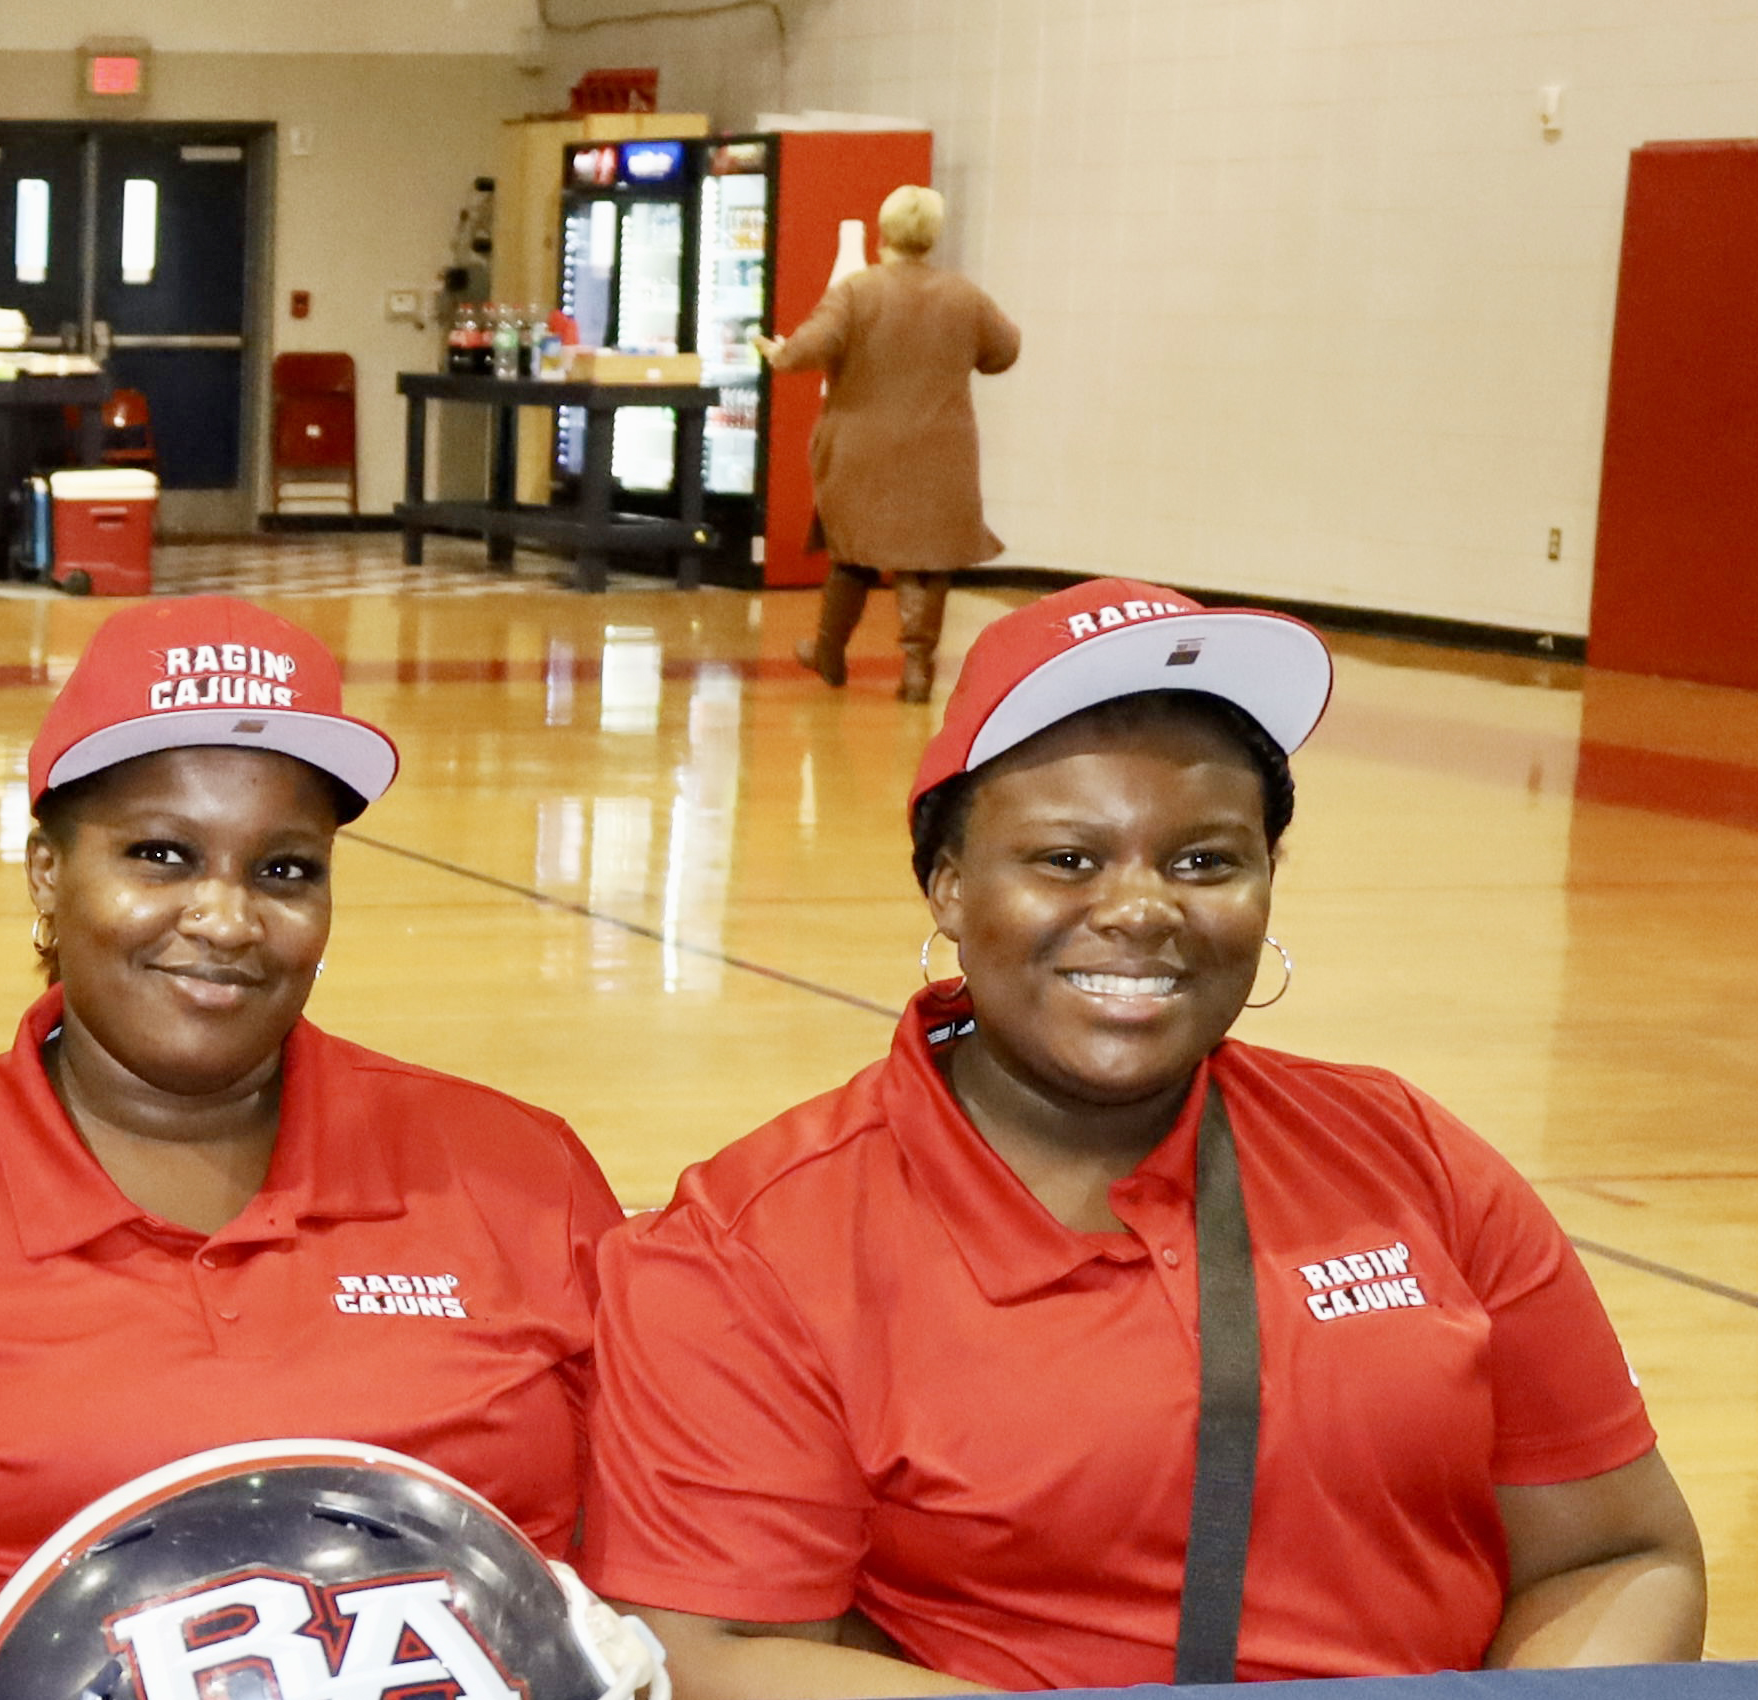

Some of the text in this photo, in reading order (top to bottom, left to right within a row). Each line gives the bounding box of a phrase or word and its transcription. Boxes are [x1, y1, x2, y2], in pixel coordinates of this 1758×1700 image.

[167, 643, 296, 682] RAGIN'
[149, 676, 294, 711] CAJUNS
[1299, 1241, 1409, 1290] RAGIN'
[338, 1273, 459, 1296] RAGIN'
[1306, 1277, 1427, 1321] CAJUNS
[335, 1293, 468, 1318] CAJUNS
